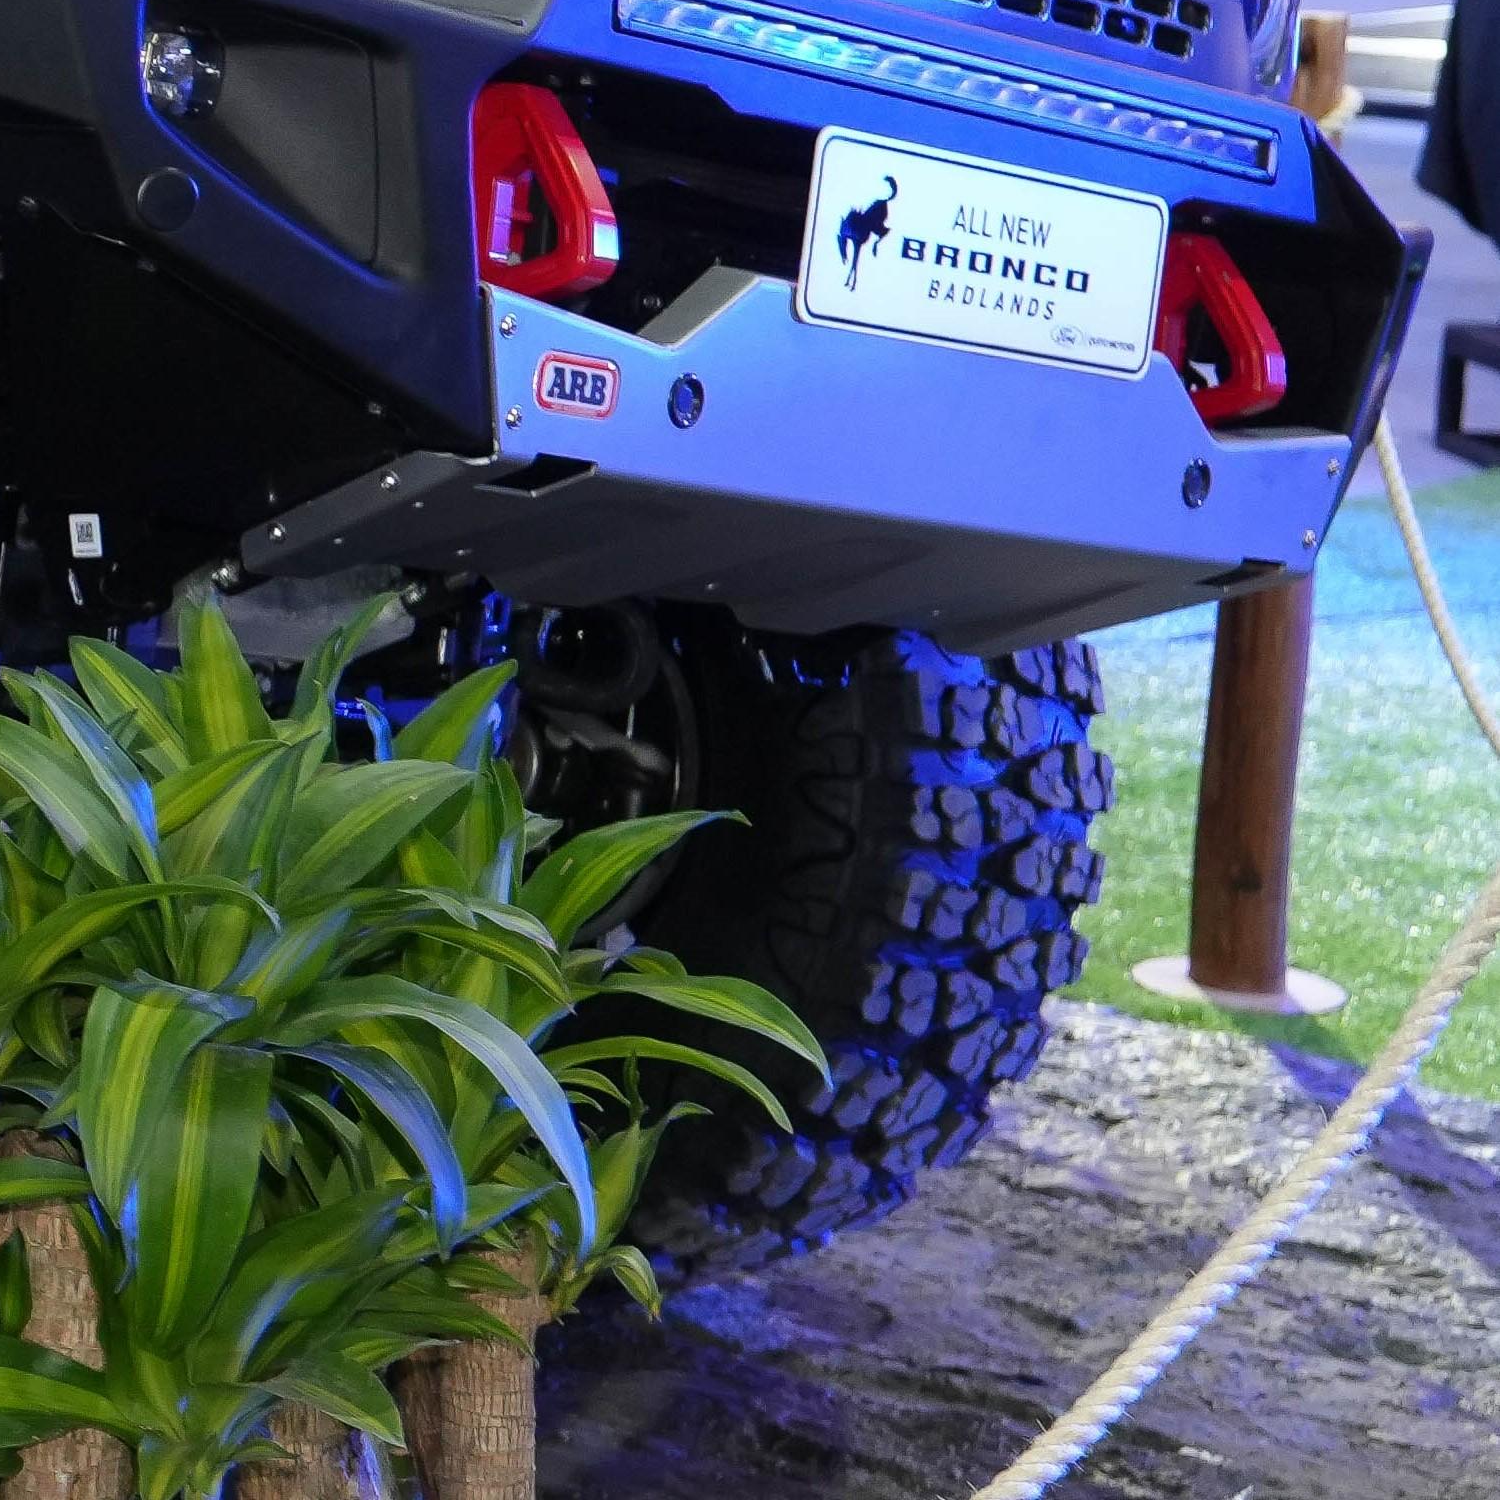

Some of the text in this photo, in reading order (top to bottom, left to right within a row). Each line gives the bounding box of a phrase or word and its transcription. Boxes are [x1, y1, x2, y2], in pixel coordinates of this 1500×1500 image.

[952, 204, 1052, 248] ALL NEW
[901, 236, 1090, 294] BRONCO
[928, 279, 1055, 321] BADLANDS
[546, 366, 607, 406] ARB
